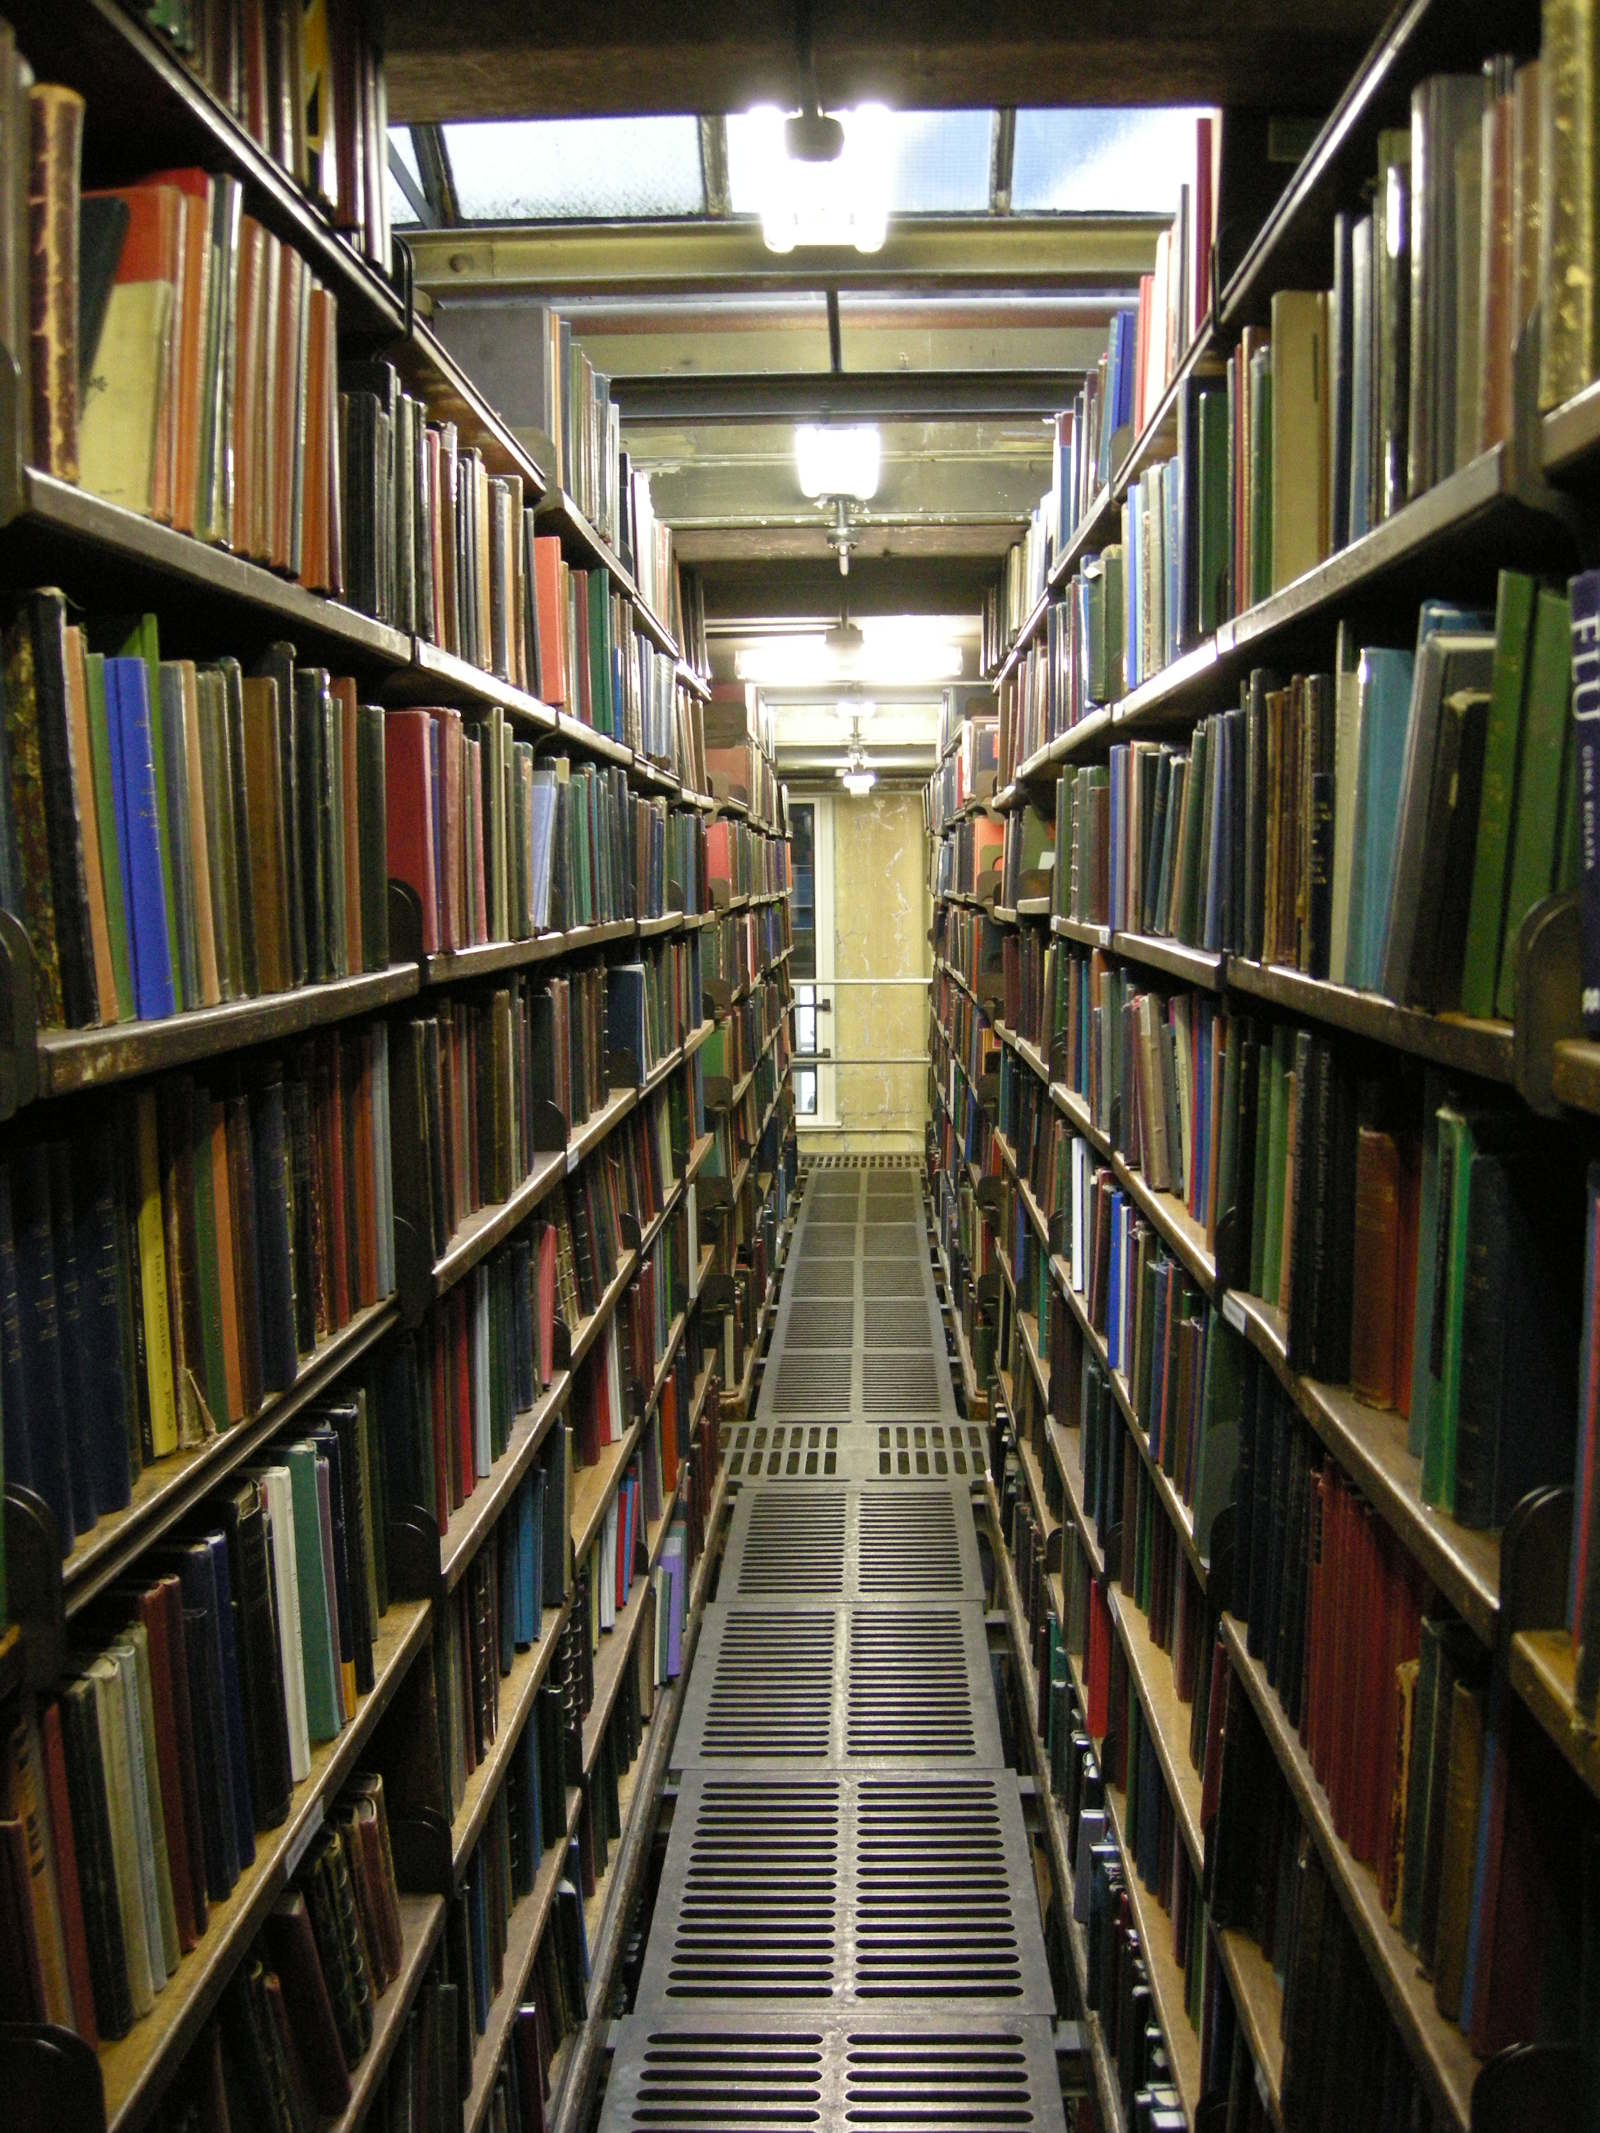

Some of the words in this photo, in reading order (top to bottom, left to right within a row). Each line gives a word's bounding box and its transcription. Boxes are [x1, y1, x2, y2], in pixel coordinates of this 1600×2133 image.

[1570, 611, 1600, 720] FLU
[1582, 744, 1594, 795] GINA
[1583, 801, 1595, 870] KOLATA
